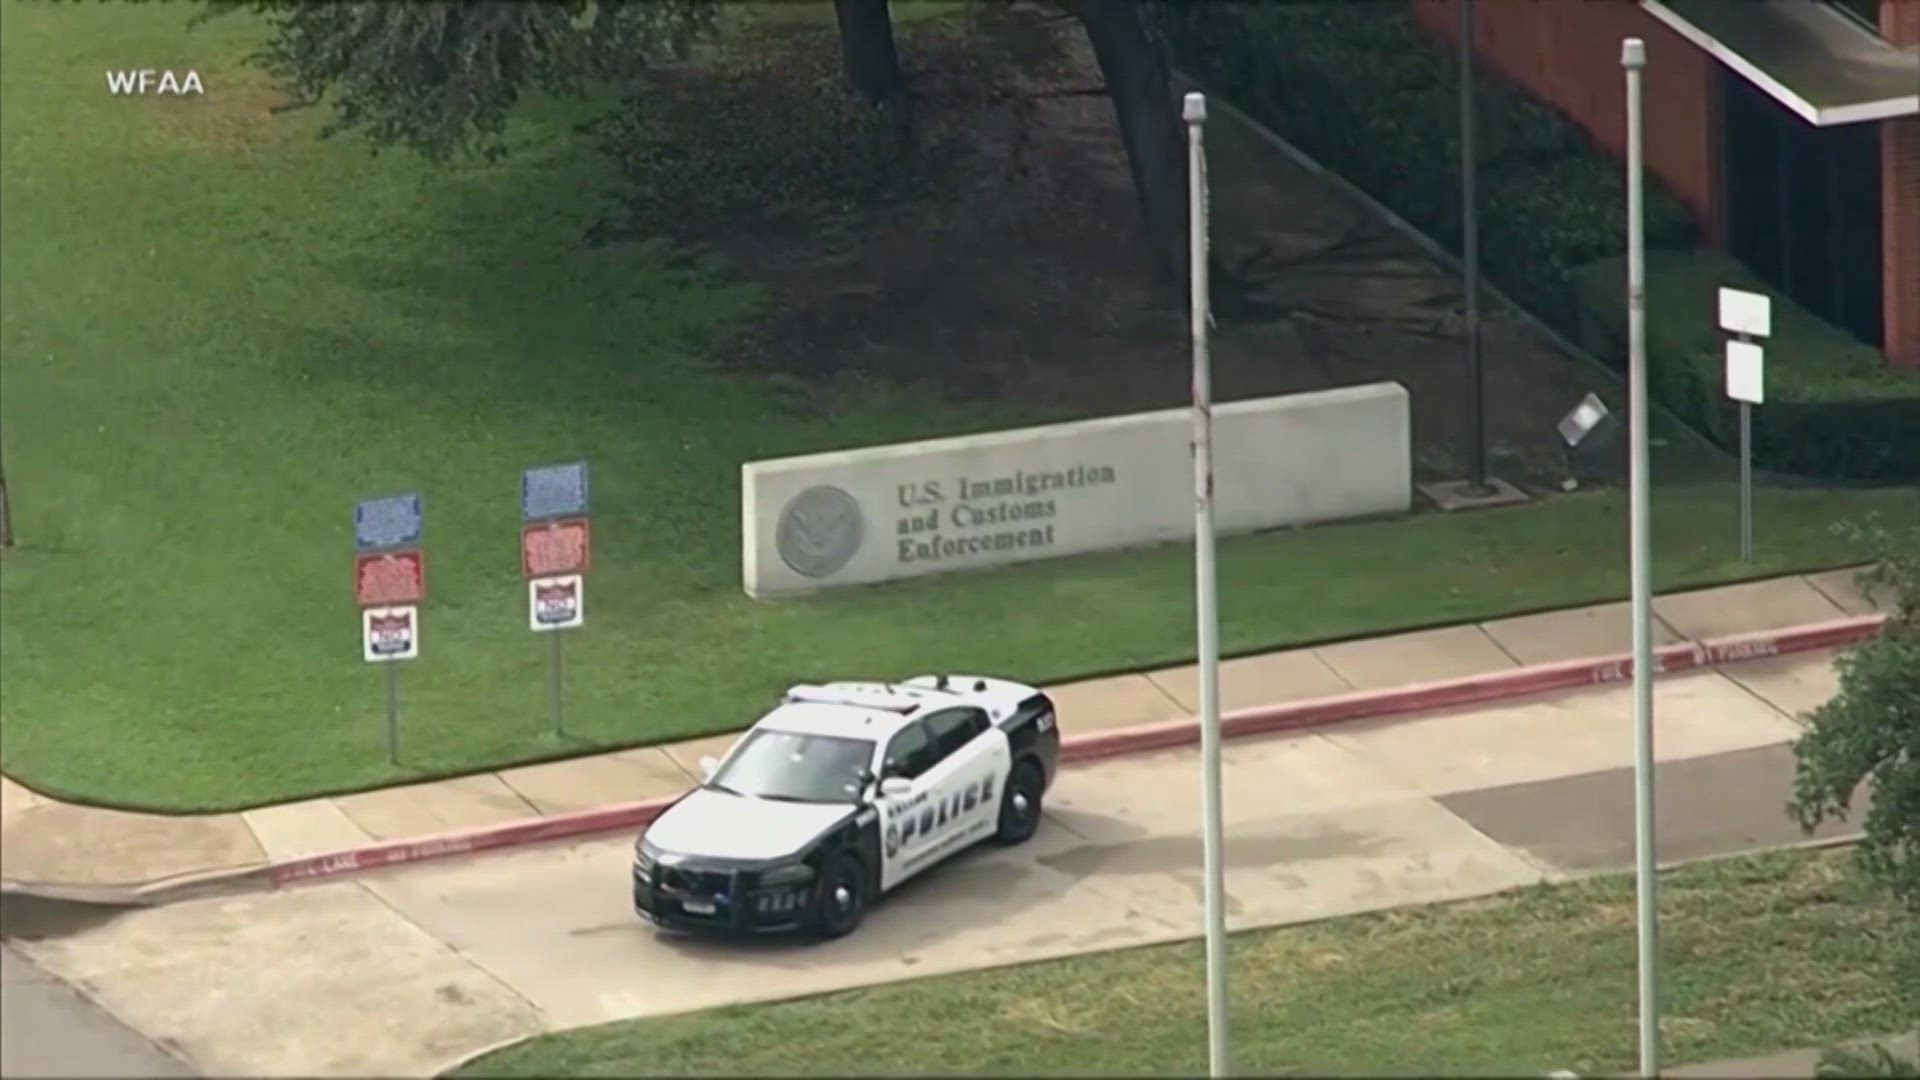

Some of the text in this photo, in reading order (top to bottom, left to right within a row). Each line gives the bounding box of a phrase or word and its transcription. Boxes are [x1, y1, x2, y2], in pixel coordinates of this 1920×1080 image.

[897, 465, 1116, 508] U.S. Immigration
[897, 499, 1056, 535] and Customs
[897, 523, 1055, 564] Enforcement
[900, 770, 996, 847] POLICE
